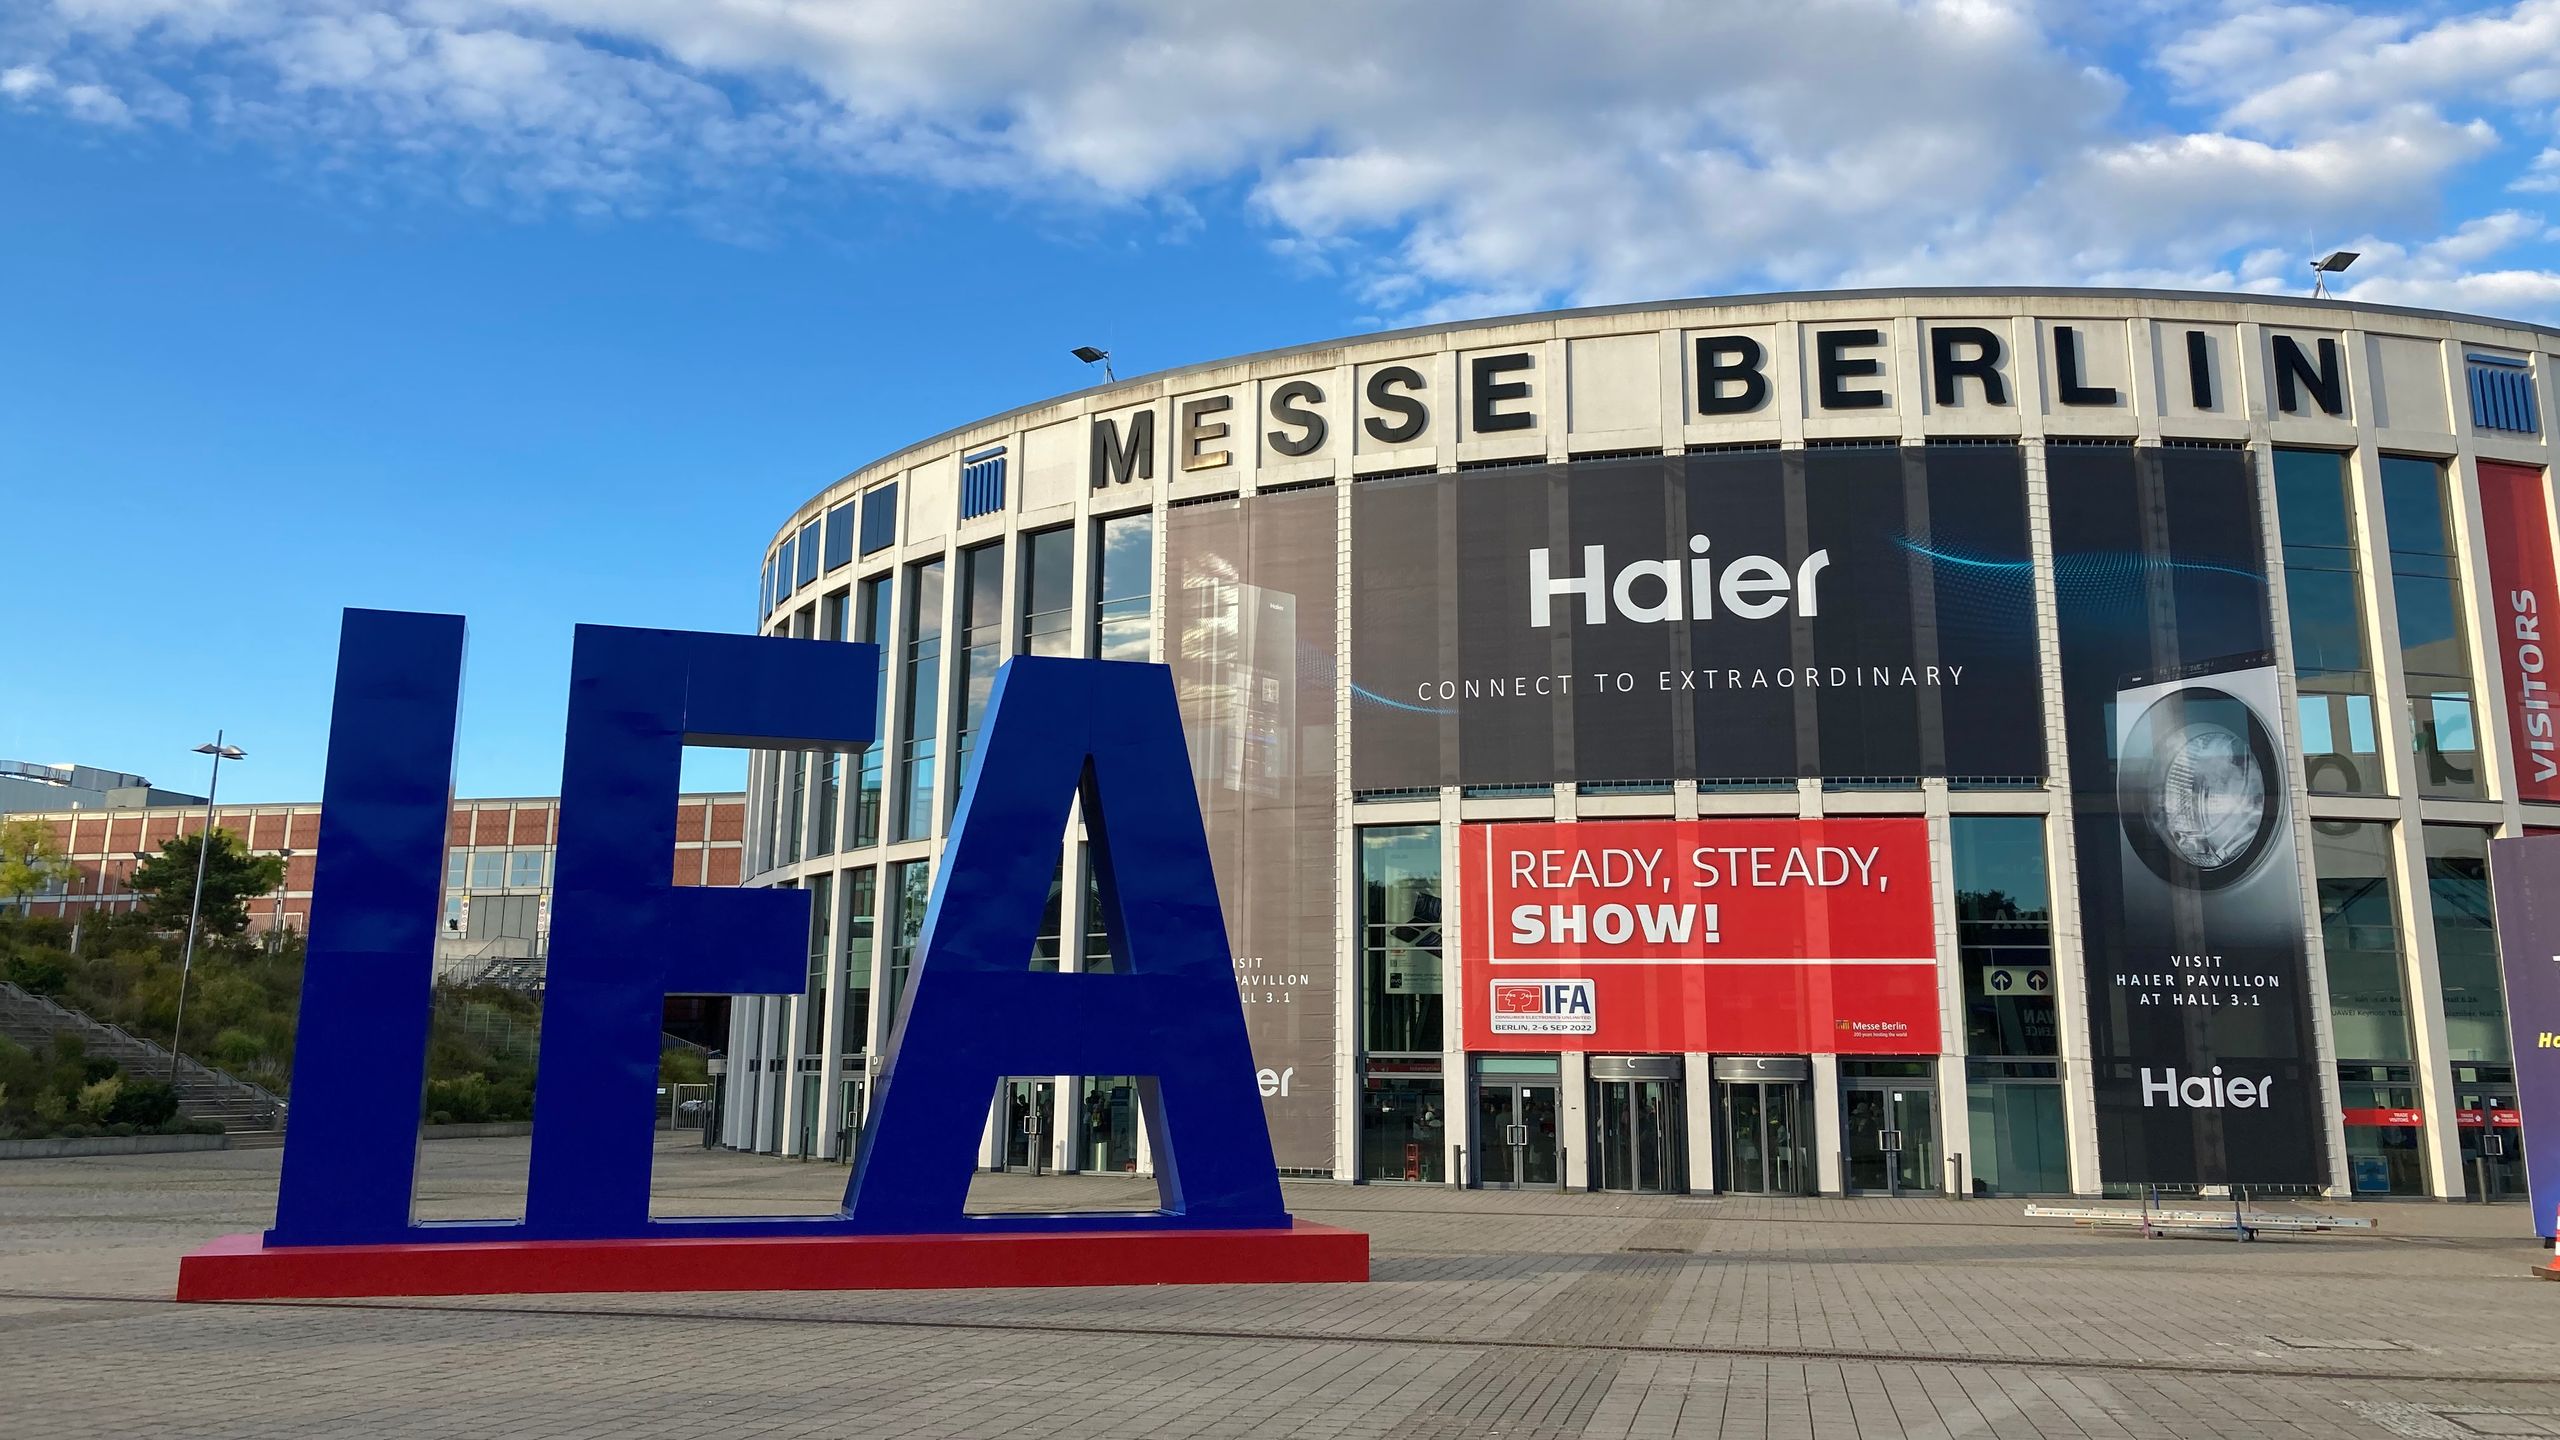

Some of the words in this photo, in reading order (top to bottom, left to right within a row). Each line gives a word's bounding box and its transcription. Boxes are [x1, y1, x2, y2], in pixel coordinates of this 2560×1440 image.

[1093, 352, 1533, 489] MESSE
[1696, 325, 2344, 415] BERLIN
[1529, 534, 1830, 628] Haier
[1418, 675, 1573, 701] CONNECT
[1595, 672, 1636, 694] TO
[1659, 665, 1965, 690] EXTRAORDINARY
[2511, 589, 2558, 783] VISITORS
[1510, 847, 1671, 894] READY,
[1692, 846, 1889, 893] STEADY,
[270, 608, 1290, 1243] IFA
[1510, 902, 1720, 944] SHOW!
[1232, 957, 1264, 969] ISIT
[2171, 955, 2222, 968] VISIT
[1235, 974, 1309, 986] AVILLON
[2116, 974, 2175, 987] HAIER
[2187, 974, 2280, 988] PAVILLON
[1266, 992, 1291, 1004] 3.1
[1545, 984, 1591, 1014] IFA
[2140, 993, 2162, 1005] AT
[2173, 993, 2220, 1006] HALL
[2230, 994, 2260, 1007] 3.1
[1495, 1024, 1531, 1032] BERLIN,
[1852, 1021, 1880, 1030] Messe
[1881, 1021, 1907, 1030] Berlin
[873, 1056, 879, 1065] D
[1626, 1057, 1635, 1069] C
[1756, 1058, 1765, 1070] C
[2140, 1065, 2273, 1109] Haier
